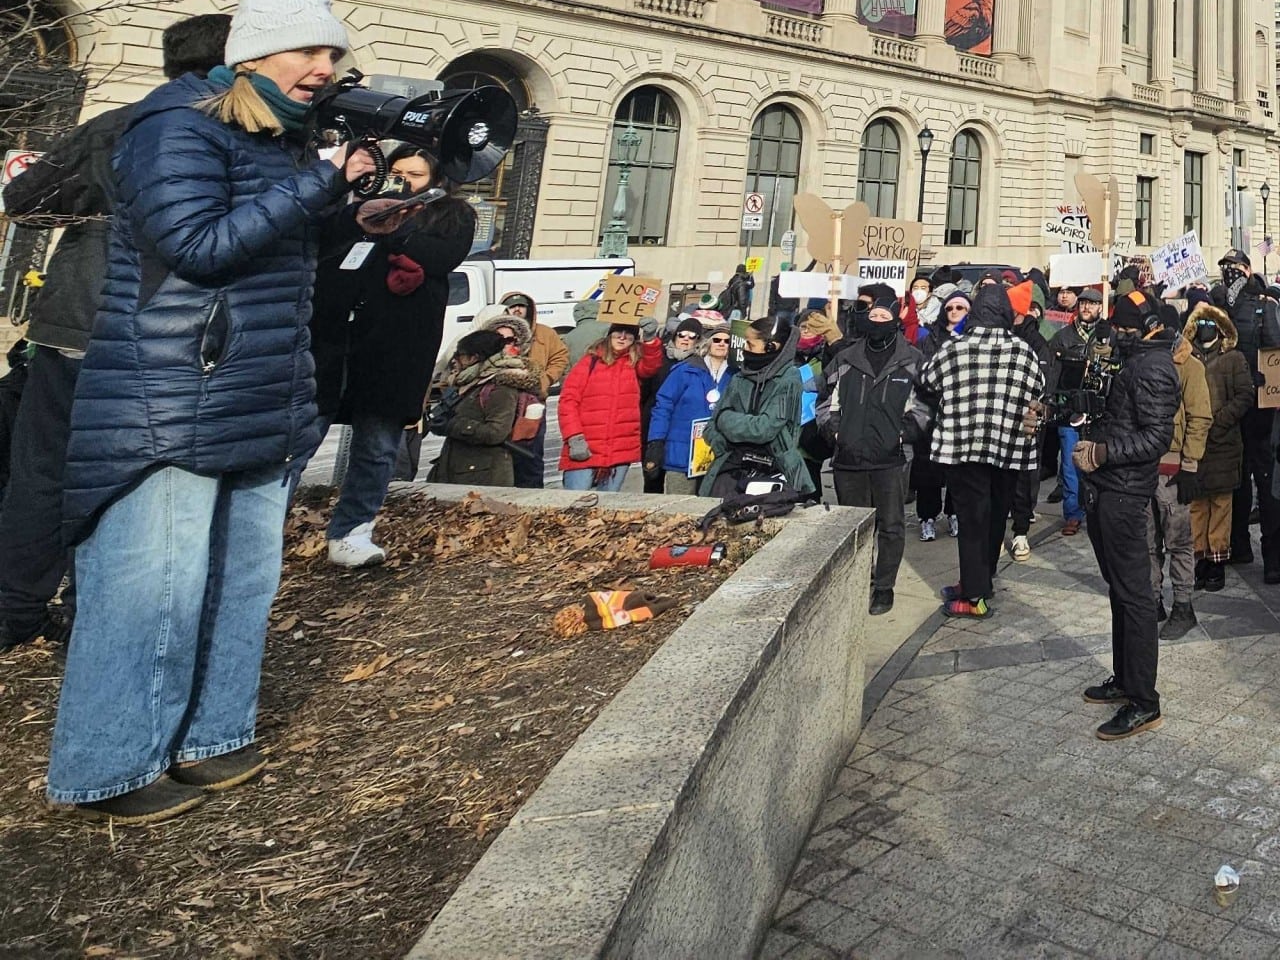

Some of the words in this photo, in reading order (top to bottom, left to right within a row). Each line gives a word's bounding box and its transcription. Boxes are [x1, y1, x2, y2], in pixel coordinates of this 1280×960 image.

[403, 111, 430, 123] PYLE
[1057, 205, 1072, 214] WE
[1165, 248, 1190, 269] ICE
[859, 265, 905, 280] ENOUGH
[616, 283, 644, 296] NO
[602, 300, 648, 317] ICE
